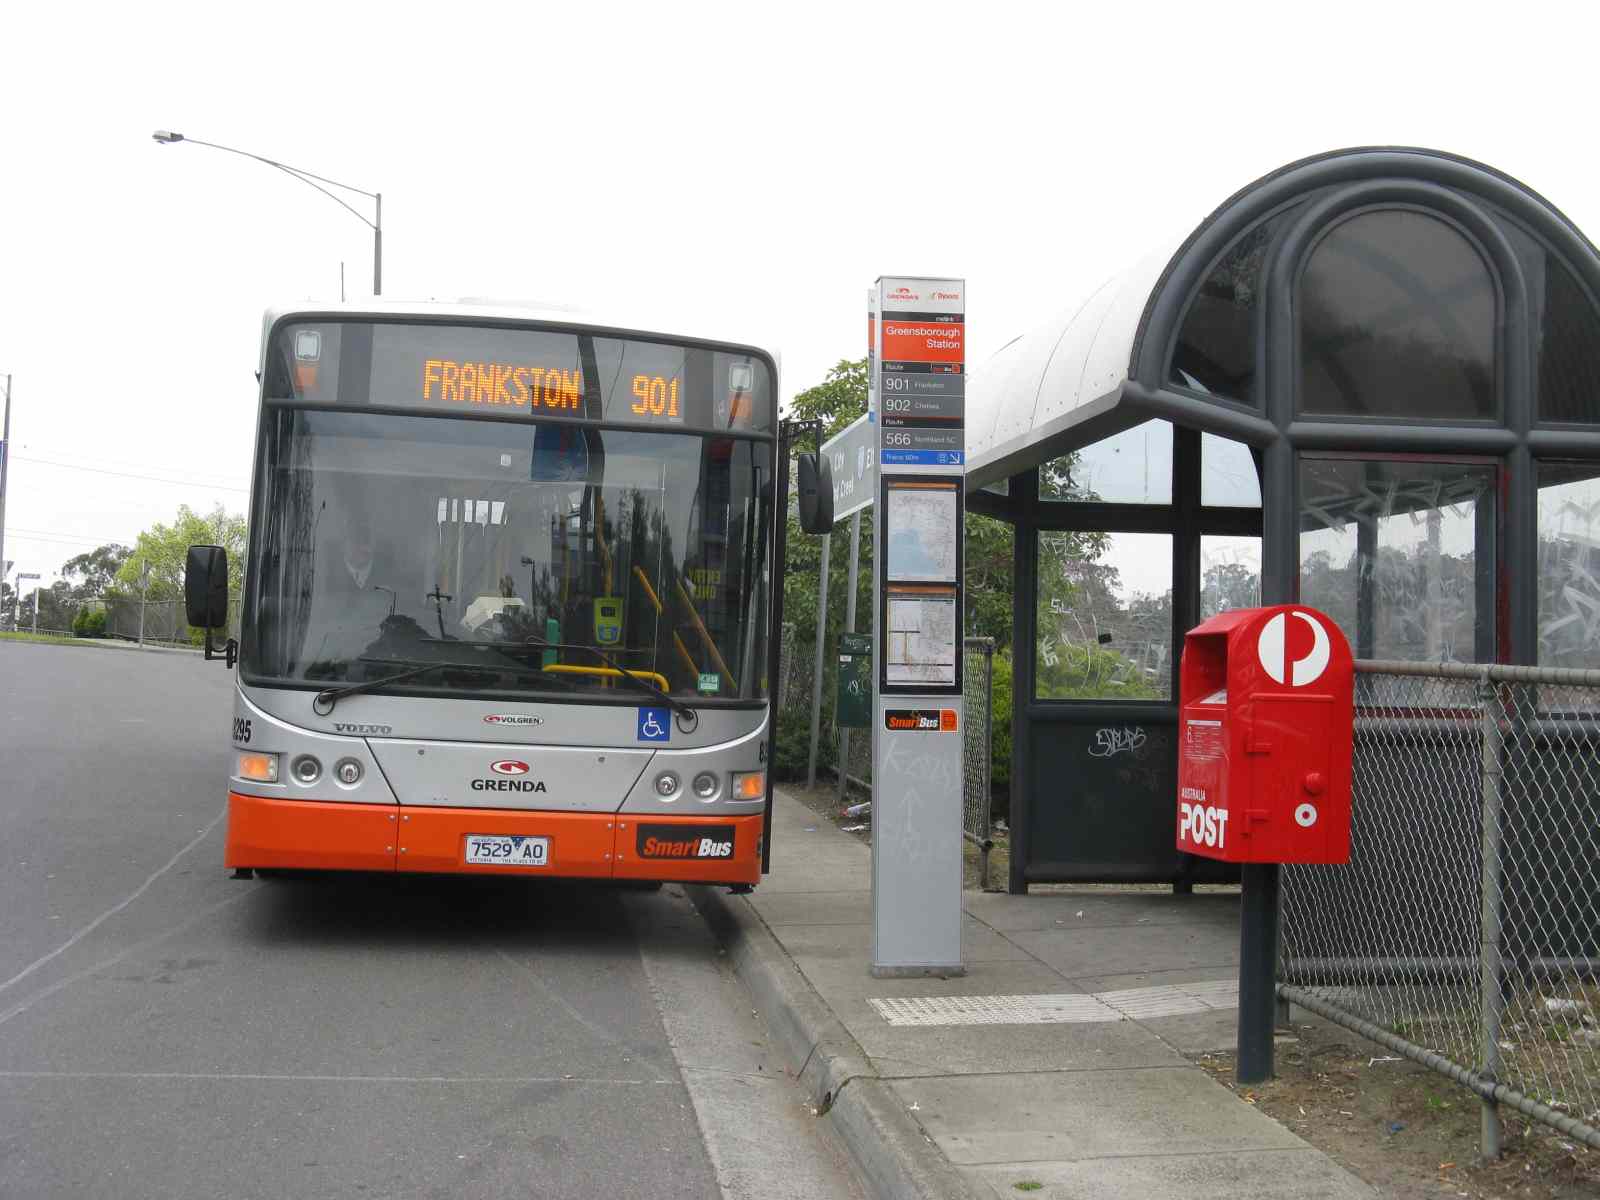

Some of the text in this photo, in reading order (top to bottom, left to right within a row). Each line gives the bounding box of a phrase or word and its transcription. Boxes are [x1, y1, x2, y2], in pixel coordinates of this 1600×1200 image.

[886, 326, 960, 340] Greensborough
[926, 338, 960, 349] Station
[423, 360, 681, 417] FRANKSTON 901
[886, 378, 909, 390] 901
[886, 399, 911, 411] 902
[886, 433, 911, 445] 566
[500, 716, 540, 725] VOLGREN
[333, 723, 393, 735] VOLVO
[471, 779, 547, 792] GRENDA
[1181, 787, 1206, 801] AUSTRALIA
[1180, 802, 1229, 849] POST
[471, 842, 512, 857] 7529
[643, 837, 732, 857] SmartBus
